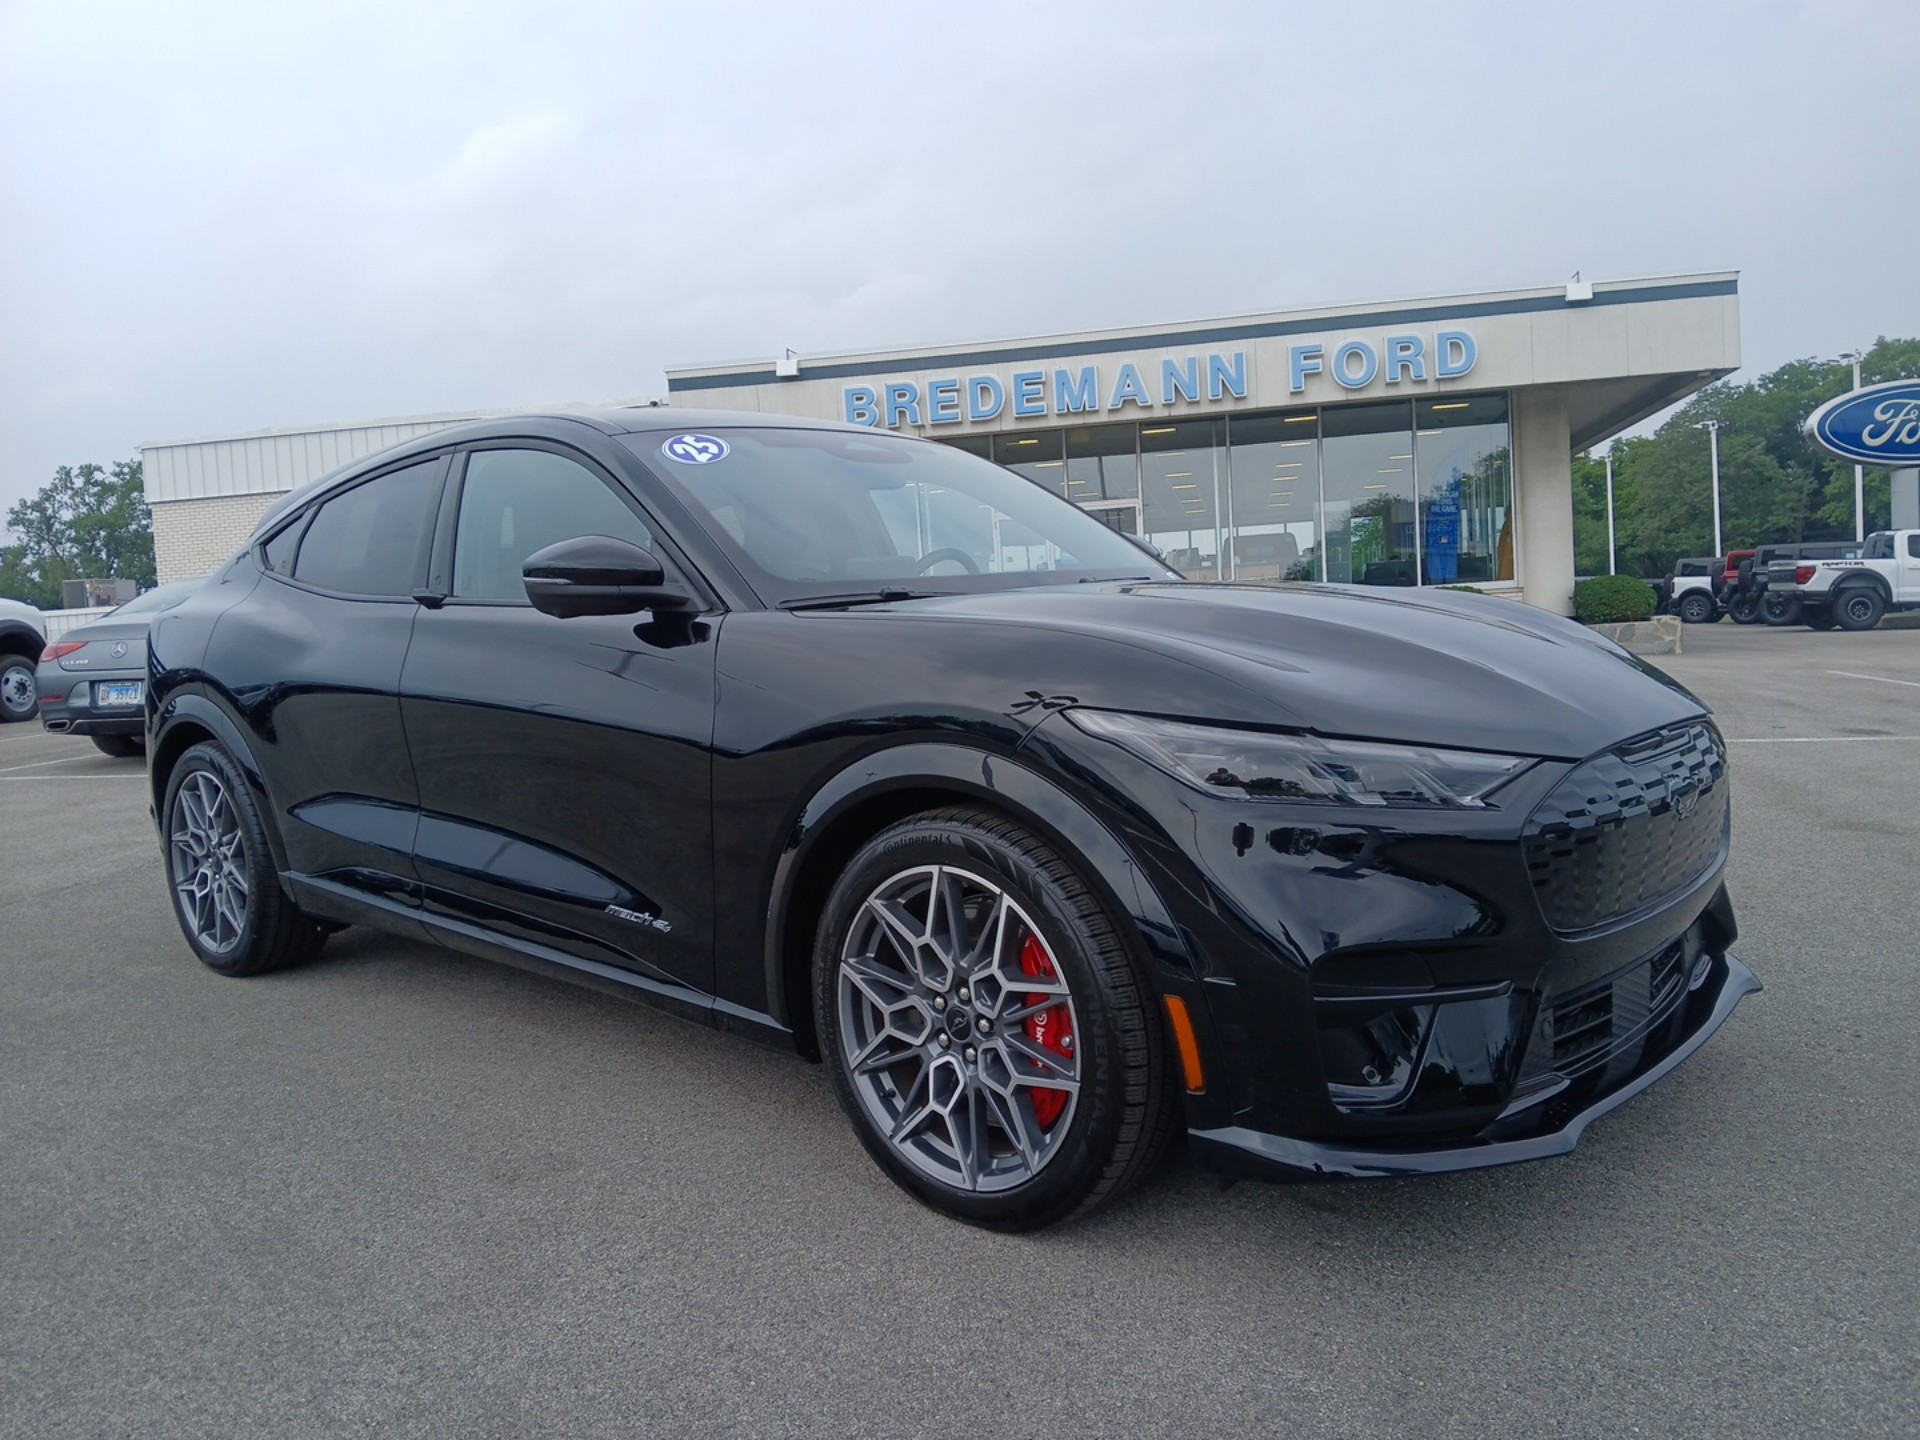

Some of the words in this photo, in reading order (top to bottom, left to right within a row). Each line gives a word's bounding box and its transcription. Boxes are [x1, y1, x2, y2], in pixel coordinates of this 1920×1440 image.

[843, 350, 1248, 428] BREDEMANN
[1287, 330, 1478, 393] FORD
[672, 434, 720, 463] 25
